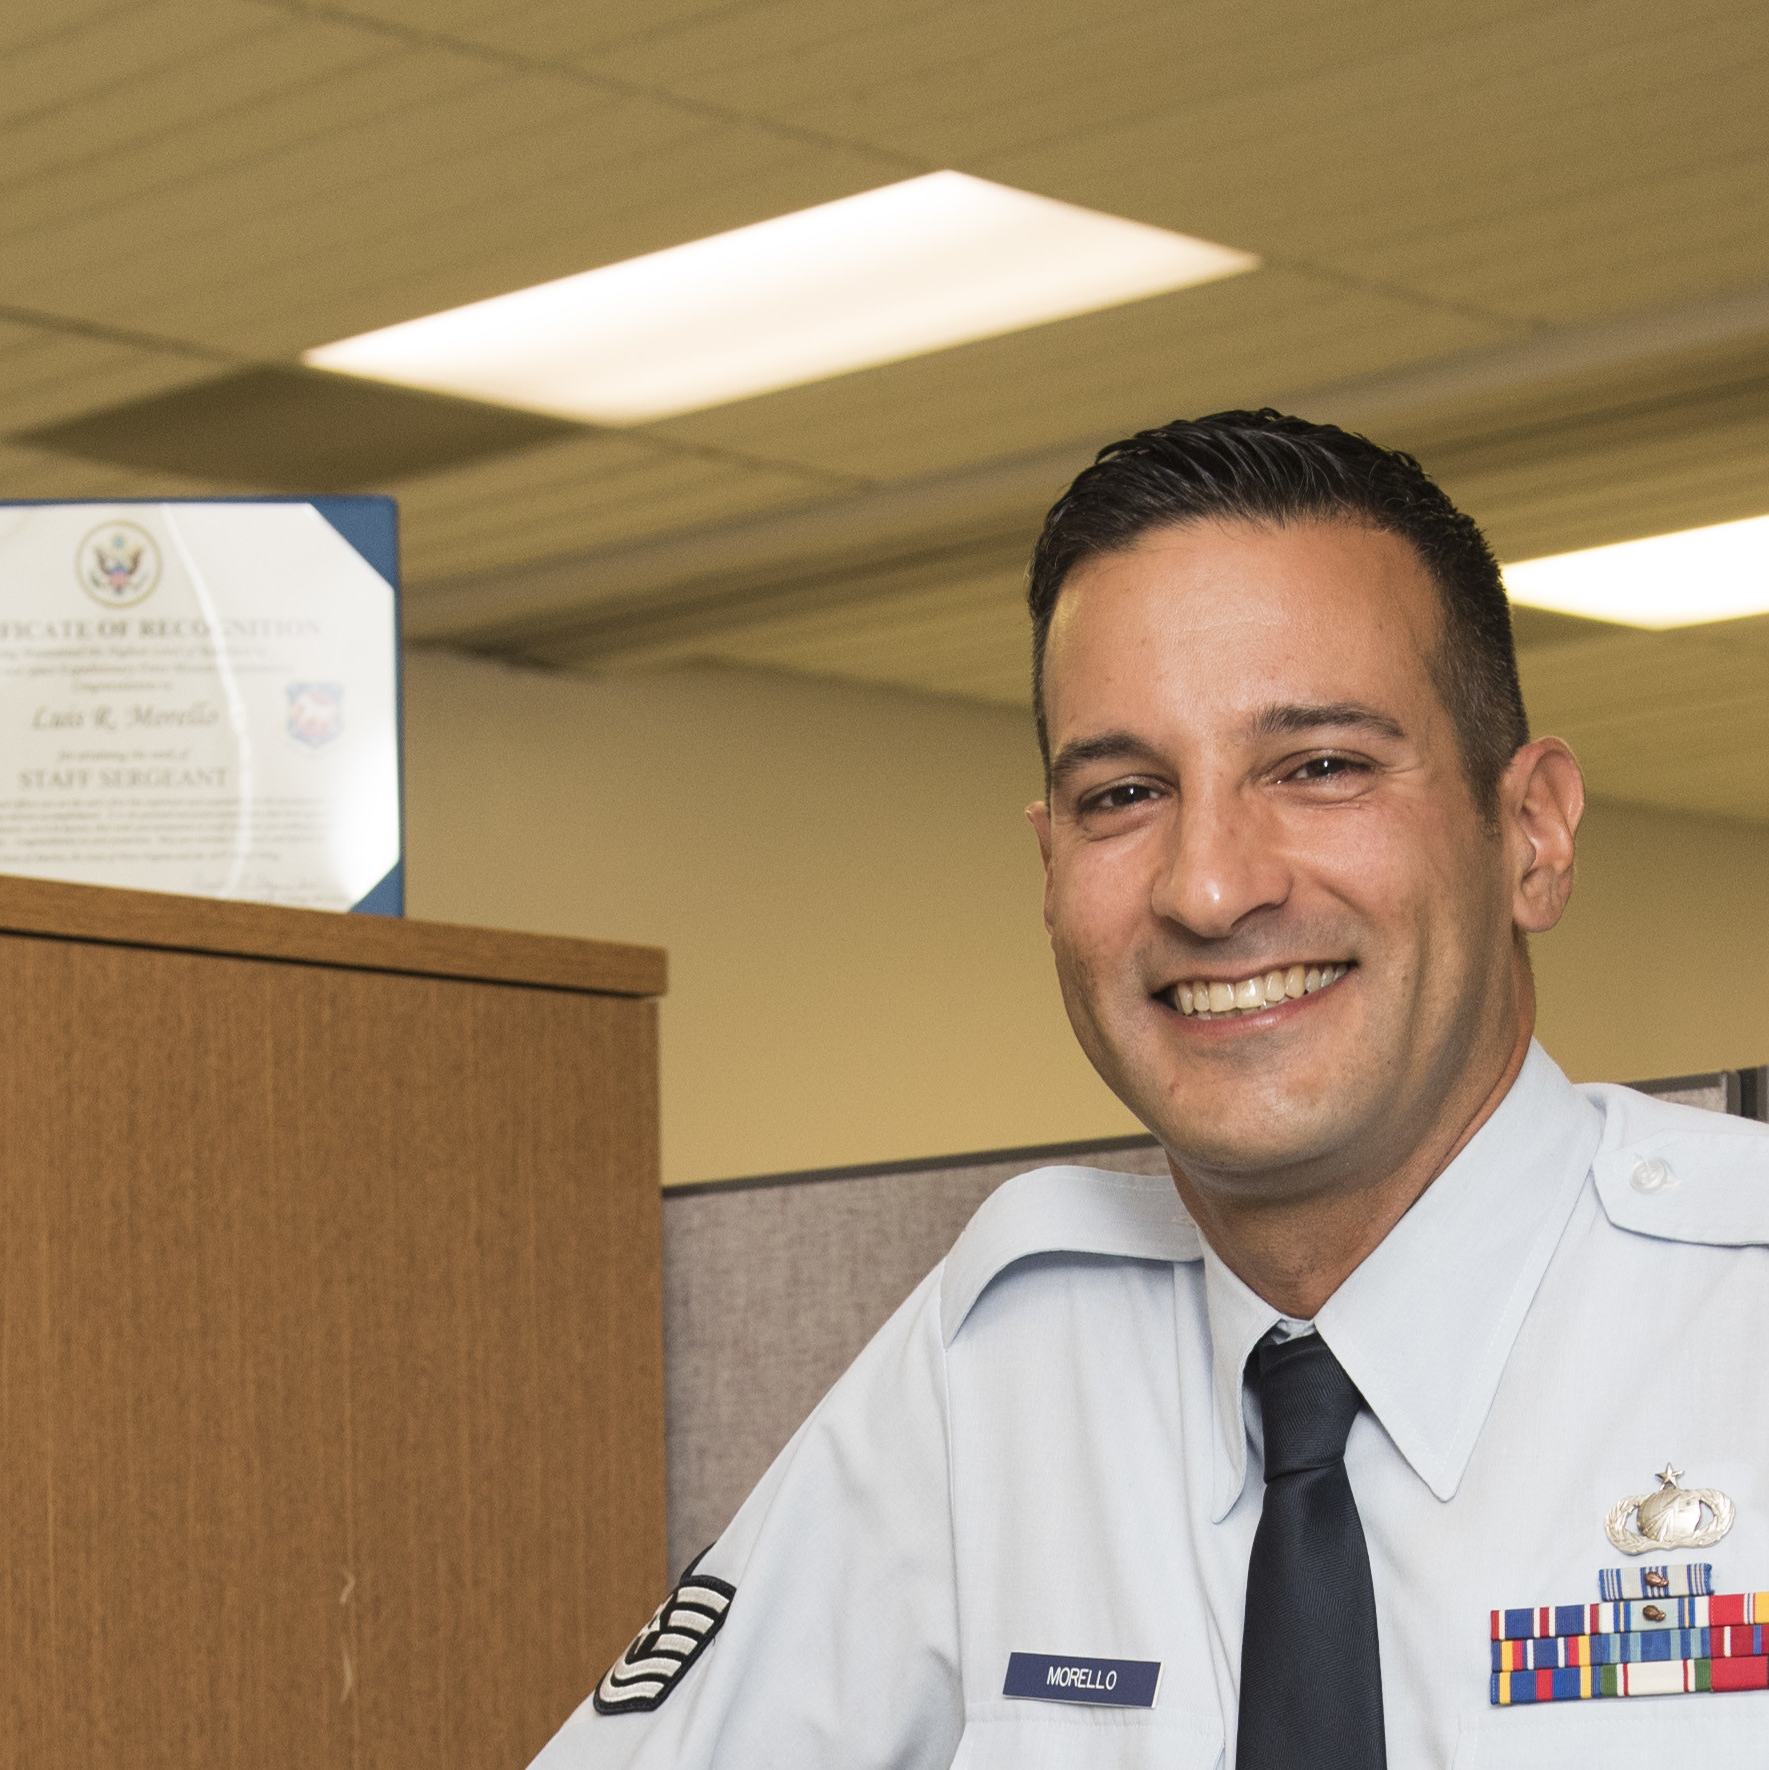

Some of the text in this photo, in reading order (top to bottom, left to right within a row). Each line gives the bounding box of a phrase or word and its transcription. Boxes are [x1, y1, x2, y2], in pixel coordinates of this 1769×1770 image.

[97, 618, 130, 640] OF
[17, 766, 89, 791] STAFF
[1046, 1666, 1118, 1690] MORELLO
